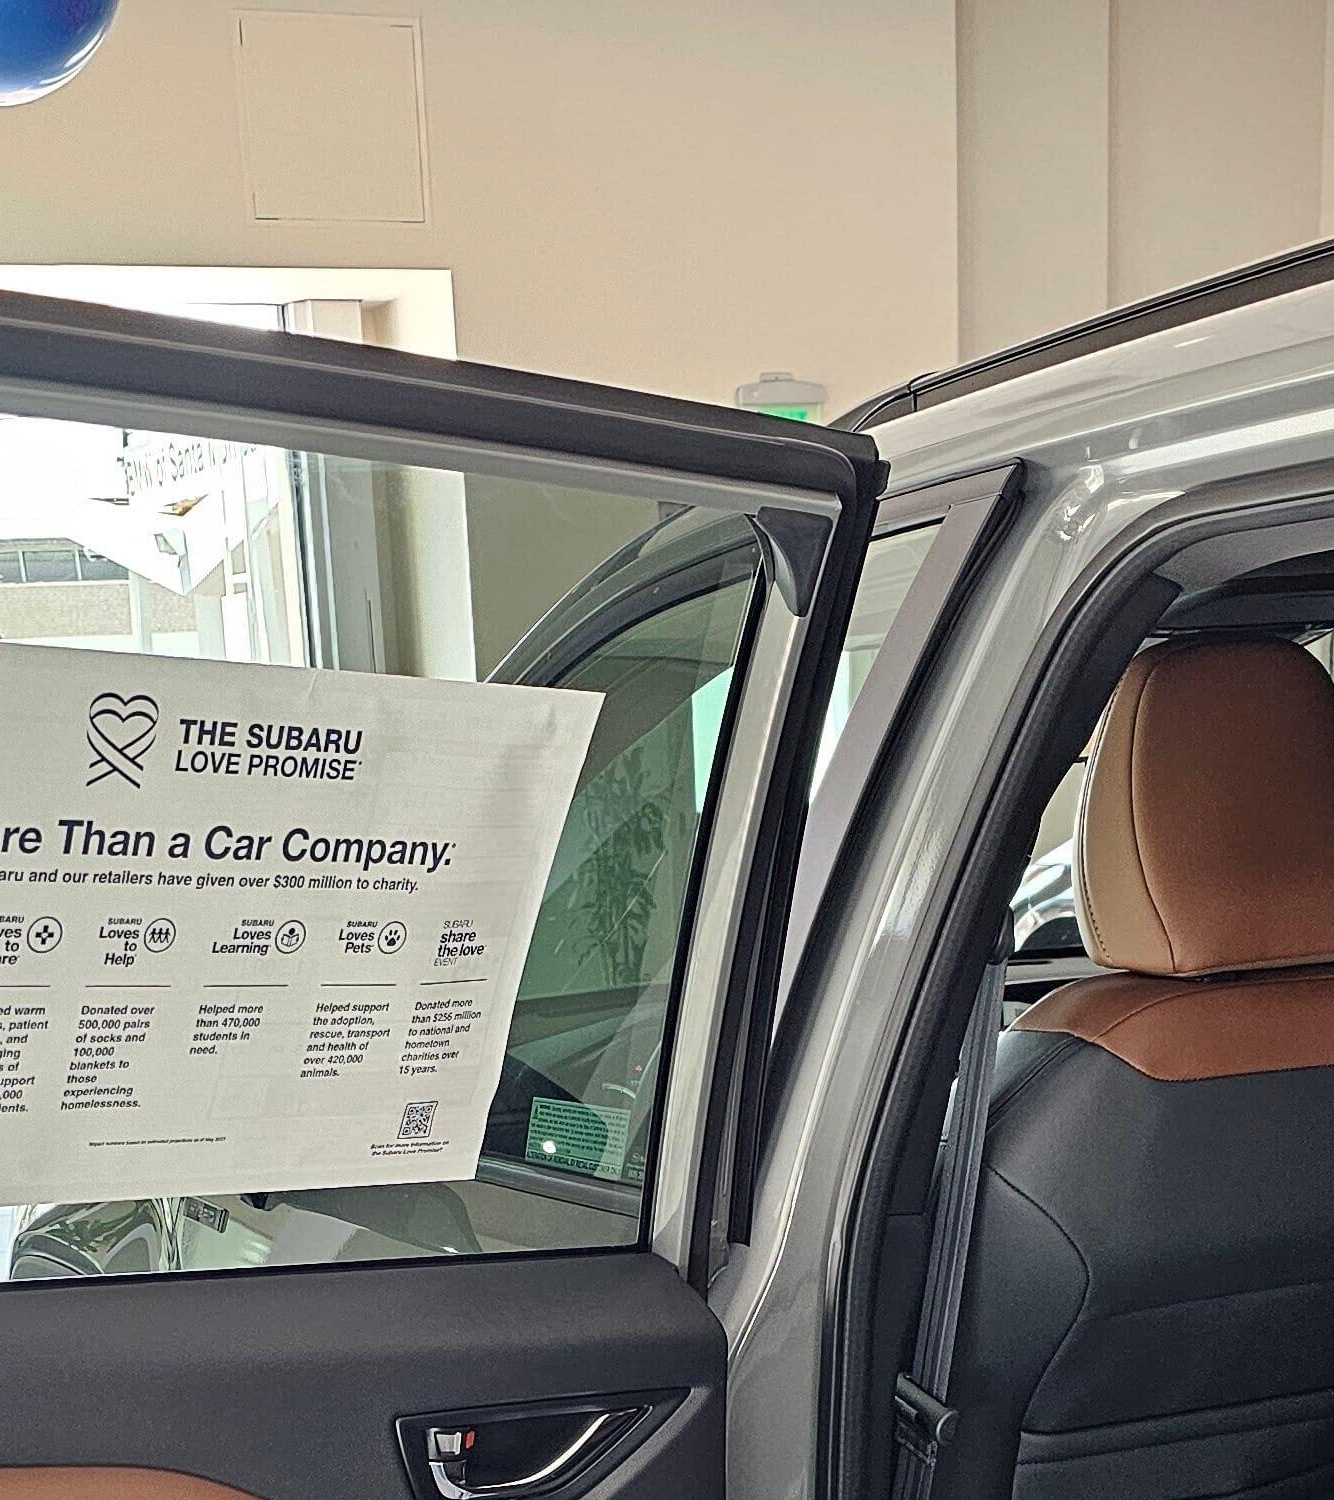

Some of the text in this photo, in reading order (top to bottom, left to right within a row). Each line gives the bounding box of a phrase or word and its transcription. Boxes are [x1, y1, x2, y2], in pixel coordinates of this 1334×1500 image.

[179, 718, 364, 755] THE SUBARU
[174, 748, 358, 781] LOVE PROMISE
[57, 819, 156, 858] Than
[167, 832, 191, 859] a
[204, 825, 273, 861] Car
[28, 868, 59, 883] and
[62, 872, 90, 884] our
[92, 869, 154, 886] retailers
[157, 871, 193, 887] have
[195, 872, 235, 890] given
[238, 876, 271, 888] over
[272, 874, 306, 890] $300
[307, 875, 353, 890] million
[356, 876, 370, 890] to
[372, 876, 419, 895] charity.
[107, 917, 143, 926] SUBARU
[240, 919, 275, 927] SUBARU
[346, 920, 379, 929] SUBARU
[98, 926, 141, 940] Loves
[232, 927, 272, 941] Loves
[338, 928, 376, 942] Loves
[439, 929, 477, 944] share
[4, 939, 20, 953] to
[123, 940, 138, 953] to
[211, 941, 272, 957] Learning
[344, 941, 375, 954] Pets
[103, 952, 135, 968] Help
[80, 1004, 156, 1016] Donated over
[198, 1003, 264, 1017] Helped more
[315, 1001, 390, 1015] Helped support
[414, 998, 474, 1011] Donated more
[14, 1007, 46, 1016] warm
[411, 1010, 482, 1024] than $256 million
[8, 1019, 49, 1033] patient
[77, 1018, 151, 1032] 500,000 pairs
[195, 1017, 261, 1029] than 470,000
[312, 1015, 375, 1028] the adoption,
[192, 1030, 251, 1042] students in
[309, 1027, 391, 1040] rescue, transport
[407, 1022, 472, 1037] to national and
[5, 1033, 29, 1045] and
[75, 1032, 147, 1044] of socks and
[404, 1039, 450, 1050] hometown
[73, 1046, 115, 1059] 100,000
[188, 1044, 218, 1055] need.
[306, 1040, 370, 1053] and health of
[303, 1053, 364, 1066] over 420,000
[400, 1050, 460, 1062] charities over
[7, 1060, 20, 1072] of
[69, 1059, 130, 1071] blankets to
[399, 1064, 438, 1077] 15 years.
[66, 1073, 98, 1085] those
[299, 1067, 340, 1078] animals.
[63, 1085, 134, 1099] experiencing
[60, 1098, 141, 1111] homelessness.
